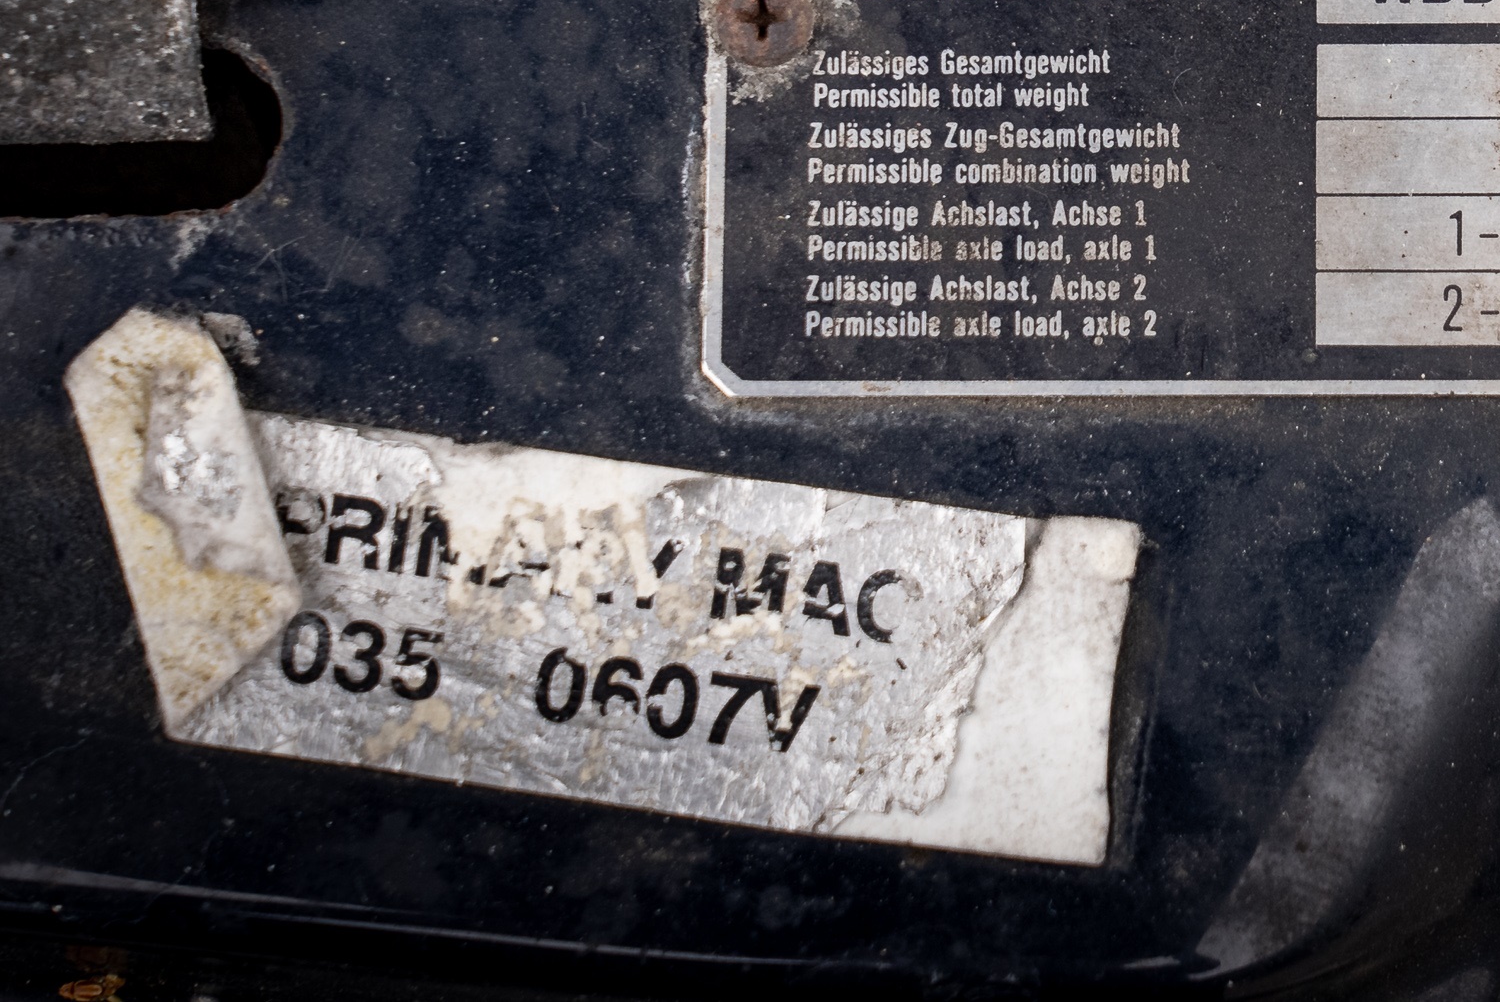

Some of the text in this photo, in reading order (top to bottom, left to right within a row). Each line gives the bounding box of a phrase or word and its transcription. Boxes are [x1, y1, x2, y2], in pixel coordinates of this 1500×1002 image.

[812, 49, 1111, 79] Zulässiges Gesamtgewicht
[813, 82, 1090, 113] Permissible total weight
[807, 121, 1181, 153] Zulässiges Zug-Gesamtgewicht
[807, 157, 1191, 189] Permissible combination weight
[806, 199, 1147, 230] Zulässige Achslast, Achse 1
[806, 234, 1157, 264] Permissible axle load, axle 1
[805, 274, 1147, 305] Zulässige Achslast, Achse 2
[804, 309, 1158, 340] Permissible axle load, axle 2
[710, 546, 925, 644] MAC
[280, 610, 445, 701] 035
